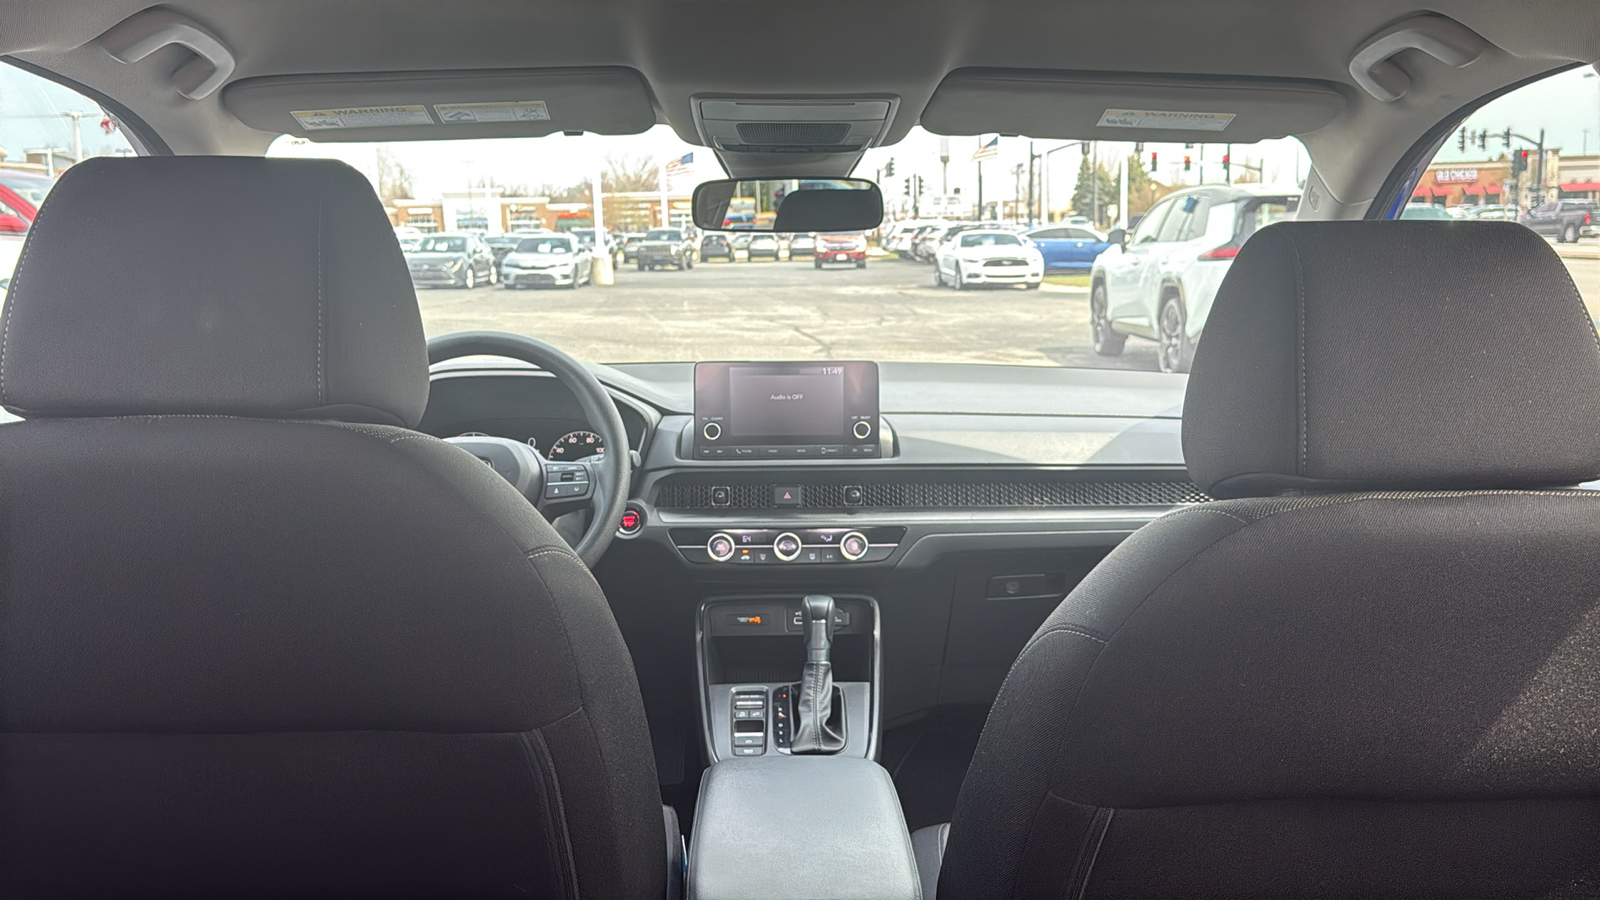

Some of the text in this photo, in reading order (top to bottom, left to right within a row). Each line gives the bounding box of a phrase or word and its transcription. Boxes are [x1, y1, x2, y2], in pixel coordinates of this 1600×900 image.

[333, 106, 407, 116] WARNING
[1144, 111, 1216, 119] WARNING
[823, 367, 842, 375] 11:49
